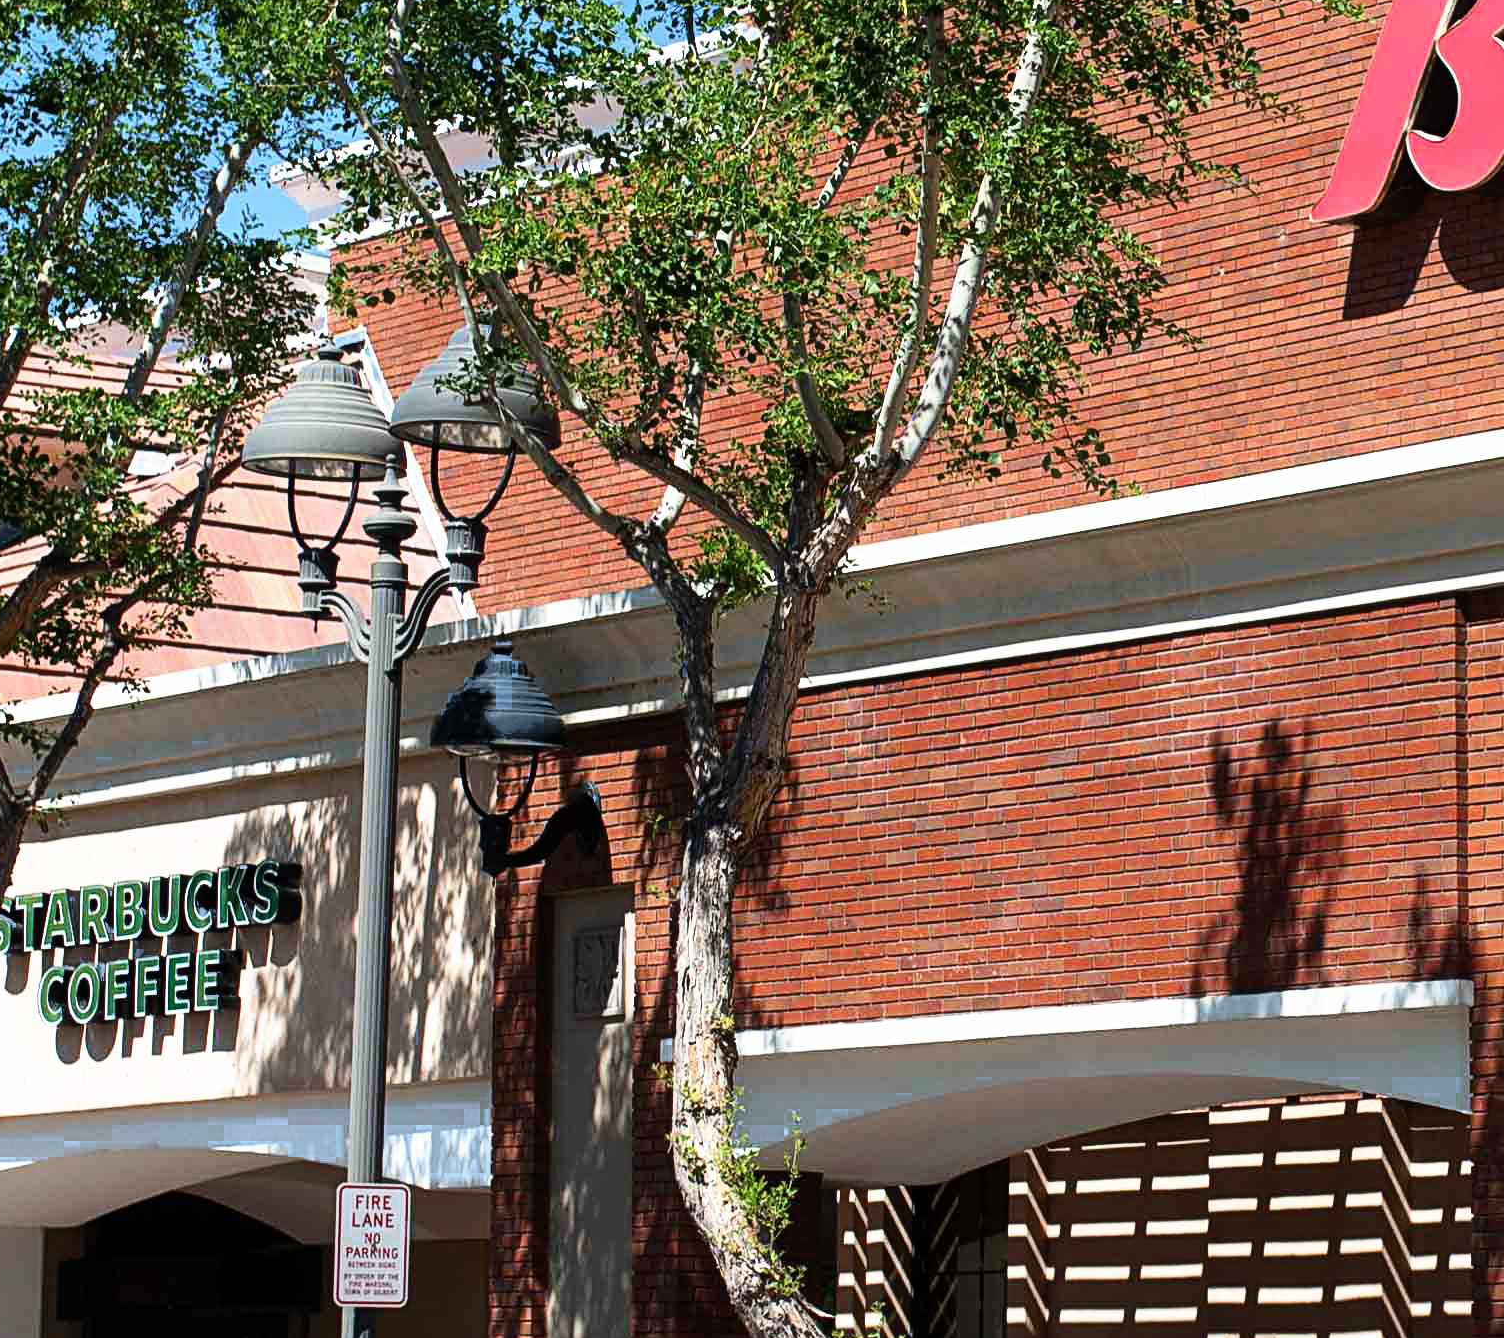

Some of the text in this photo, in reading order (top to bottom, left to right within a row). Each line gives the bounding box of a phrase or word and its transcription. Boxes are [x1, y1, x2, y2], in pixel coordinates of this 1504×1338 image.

[38, 949, 222, 1025] COFFEE
[356, 1195, 392, 1210] FIRE
[352, 1213, 394, 1228] LANE
[364, 1232, 381, 1245] NO
[346, 1246, 399, 1260] PARKING
